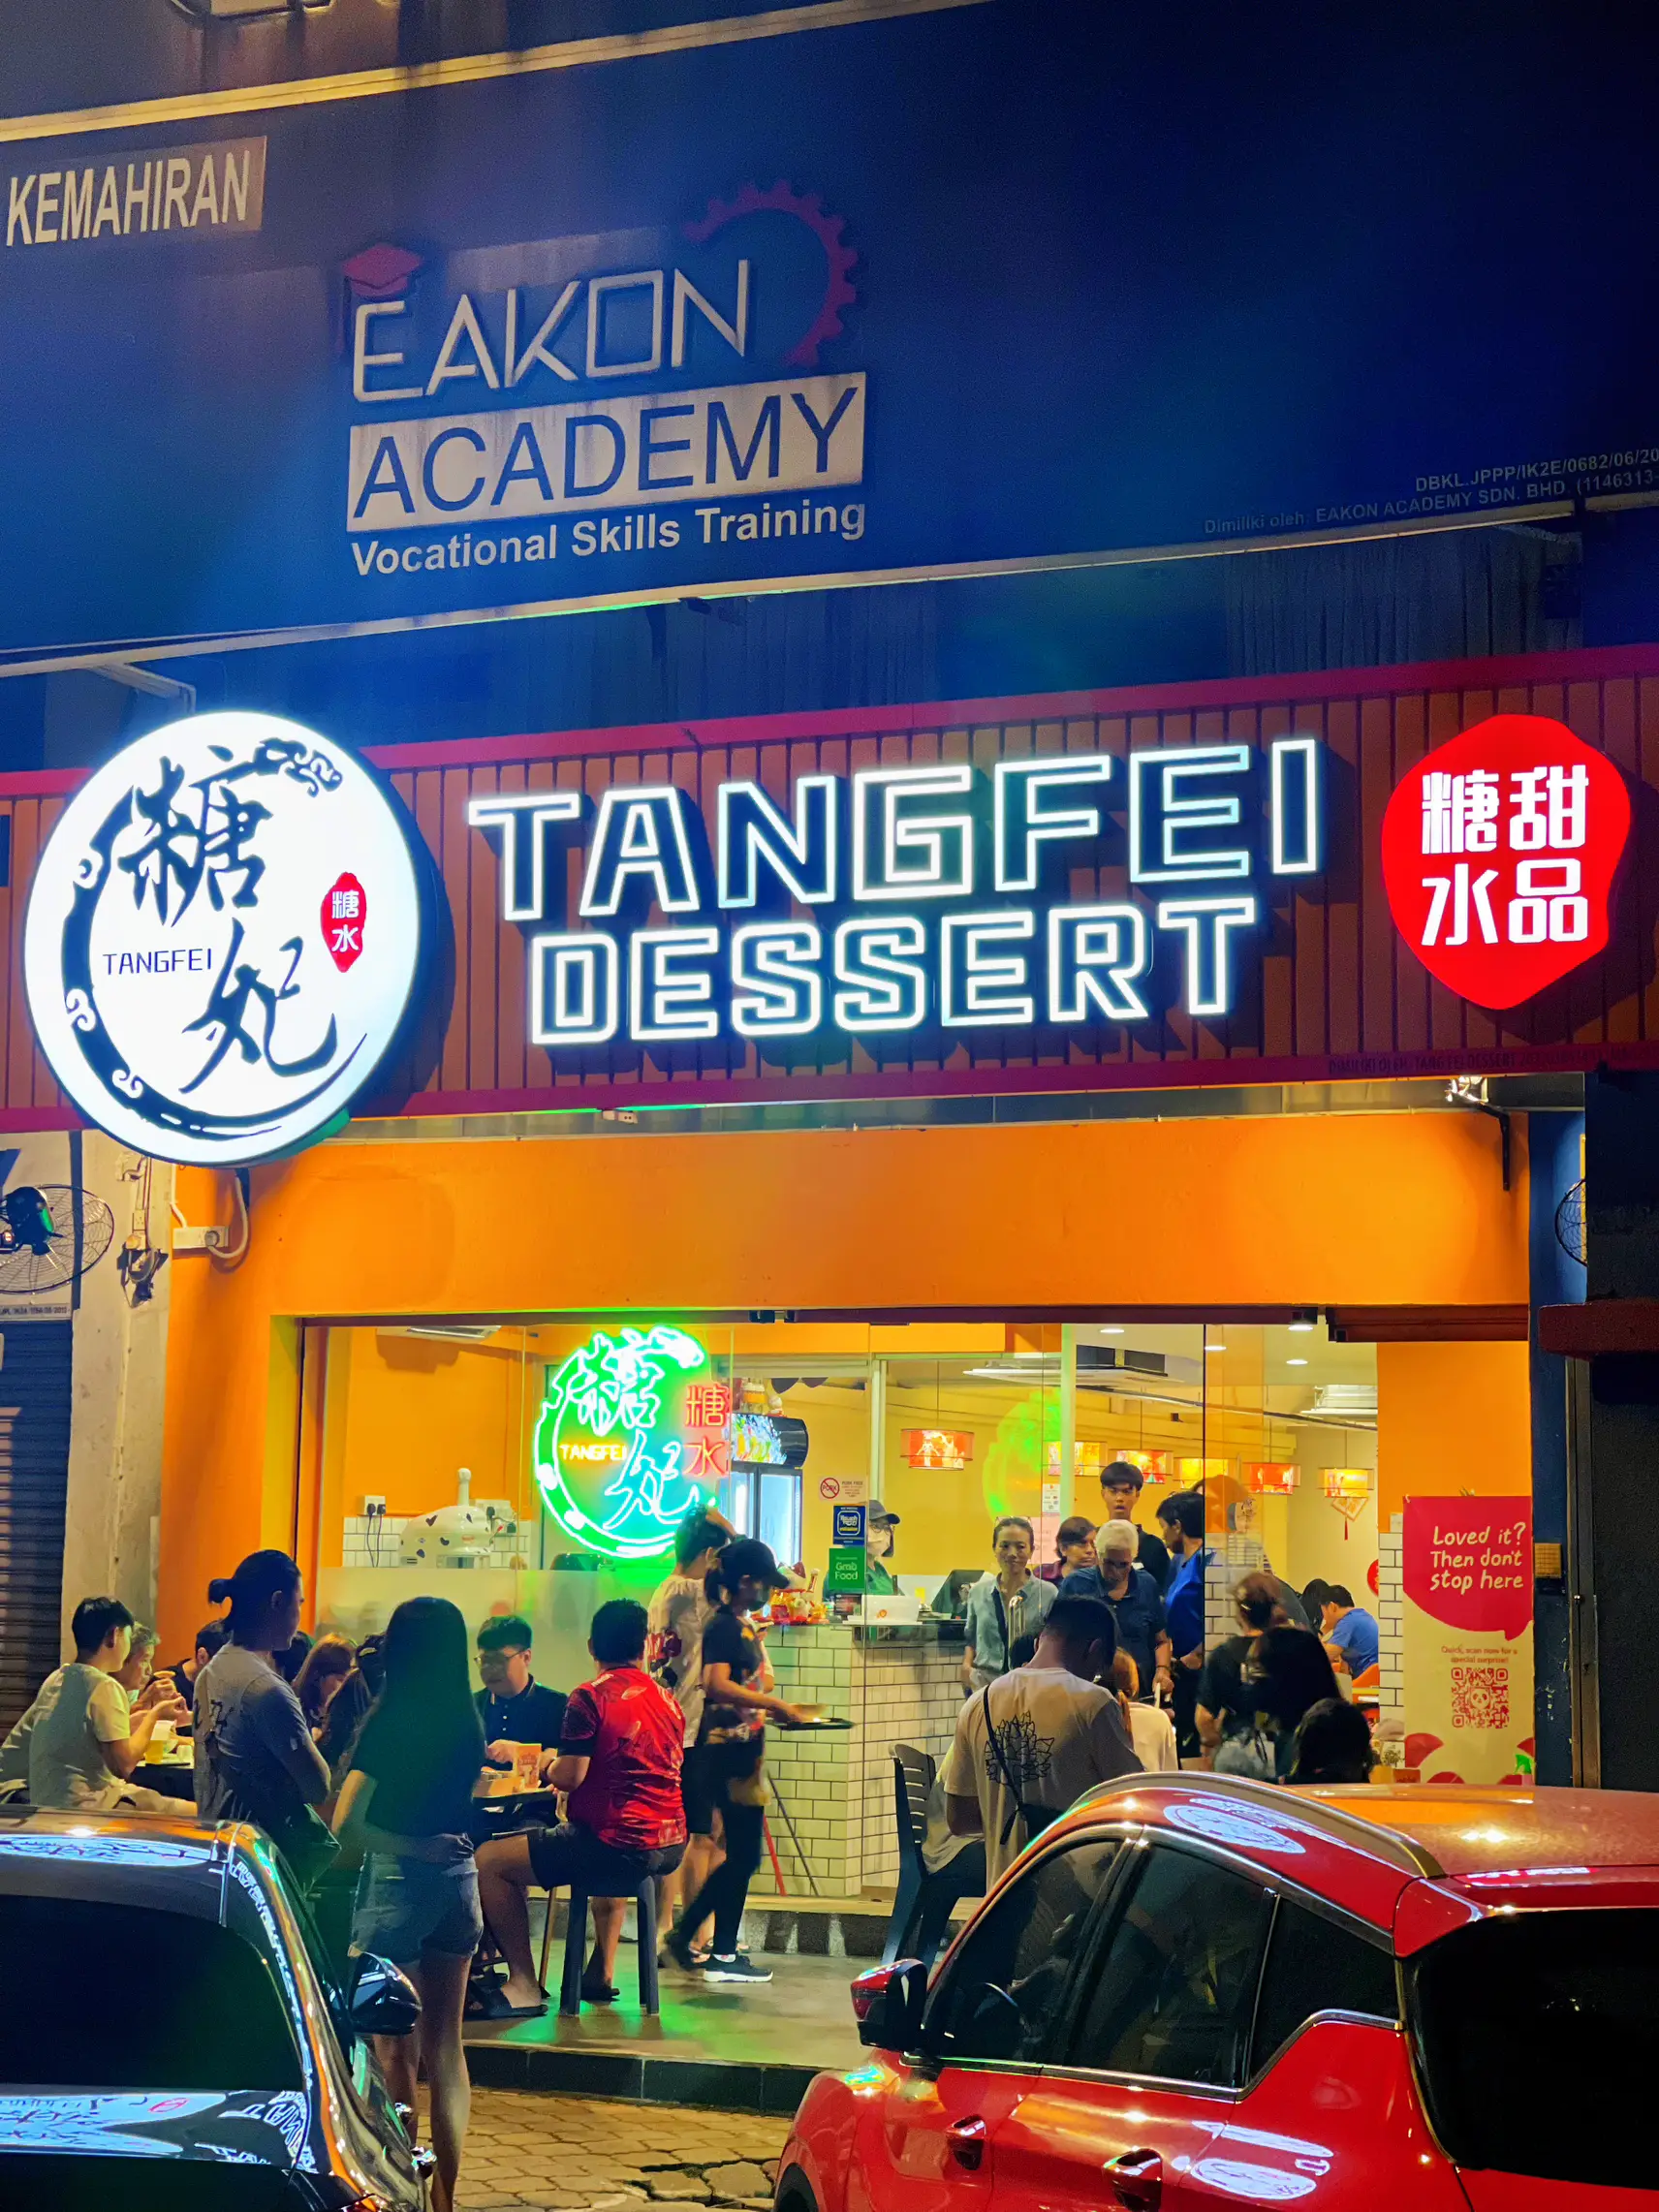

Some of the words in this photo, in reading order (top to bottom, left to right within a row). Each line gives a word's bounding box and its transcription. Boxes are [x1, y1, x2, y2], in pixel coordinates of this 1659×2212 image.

[6, 150, 250, 247] KEMAHIRAN
[352, 259, 749, 402] EAKON
[353, 386, 859, 520] ACADEMY
[1316, 503, 1378, 523] EAKON
[1384, 491, 1473, 515] ACADEMY
[1479, 486, 1520, 505] SDN.
[352, 524, 557, 576] Vocational
[572, 514, 680, 557] Skills
[695, 499, 865, 545] Training
[468, 738, 1319, 921] TANGFEI
[103, 948, 212, 976] TANGFEI
[531, 897, 1256, 1045] DESSERT
[559, 1445, 629, 1460] TANGFEI
[1433, 1526, 1490, 1545] Loved
[1498, 1521, 1526, 1547] it?
[835, 1562, 858, 1571] Grab
[1430, 1550, 1474, 1568] Then
[1480, 1547, 1522, 1567] don't
[834, 1571, 859, 1580] Food
[1430, 1570, 1473, 1595] stop
[1480, 1569, 1523, 1589] here
